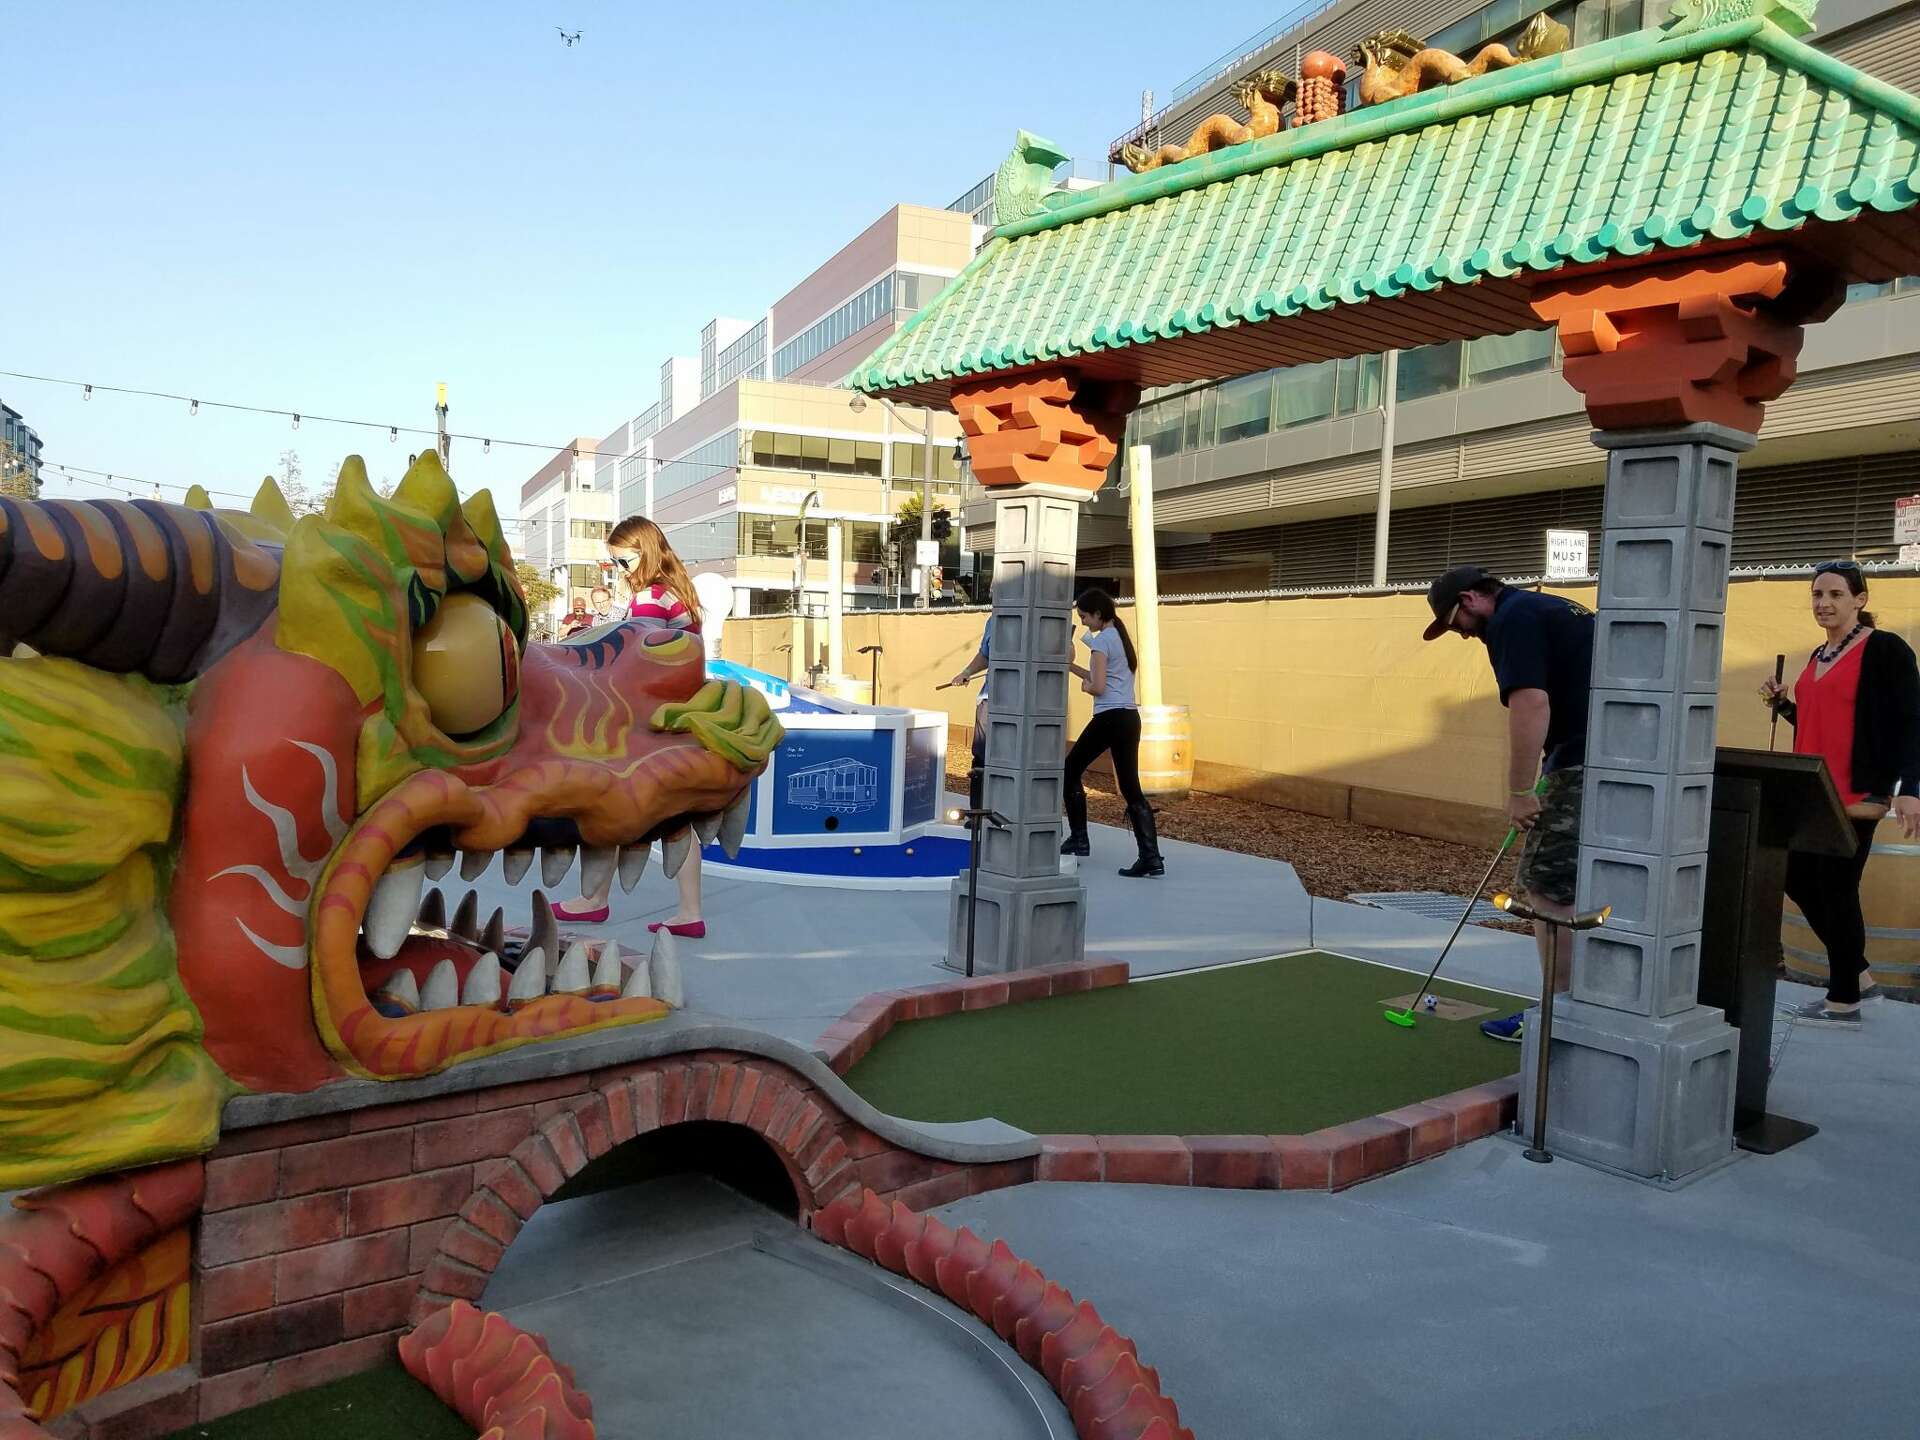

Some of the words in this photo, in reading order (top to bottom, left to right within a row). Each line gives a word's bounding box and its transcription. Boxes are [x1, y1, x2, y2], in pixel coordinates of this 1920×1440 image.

[1551, 537, 1567, 546] RIGHT
[1570, 538, 1585, 547] LANE
[1553, 551, 1582, 561] MUST
[1550, 565, 1565, 574] TURN
[1568, 566, 1585, 575] RIGHT
